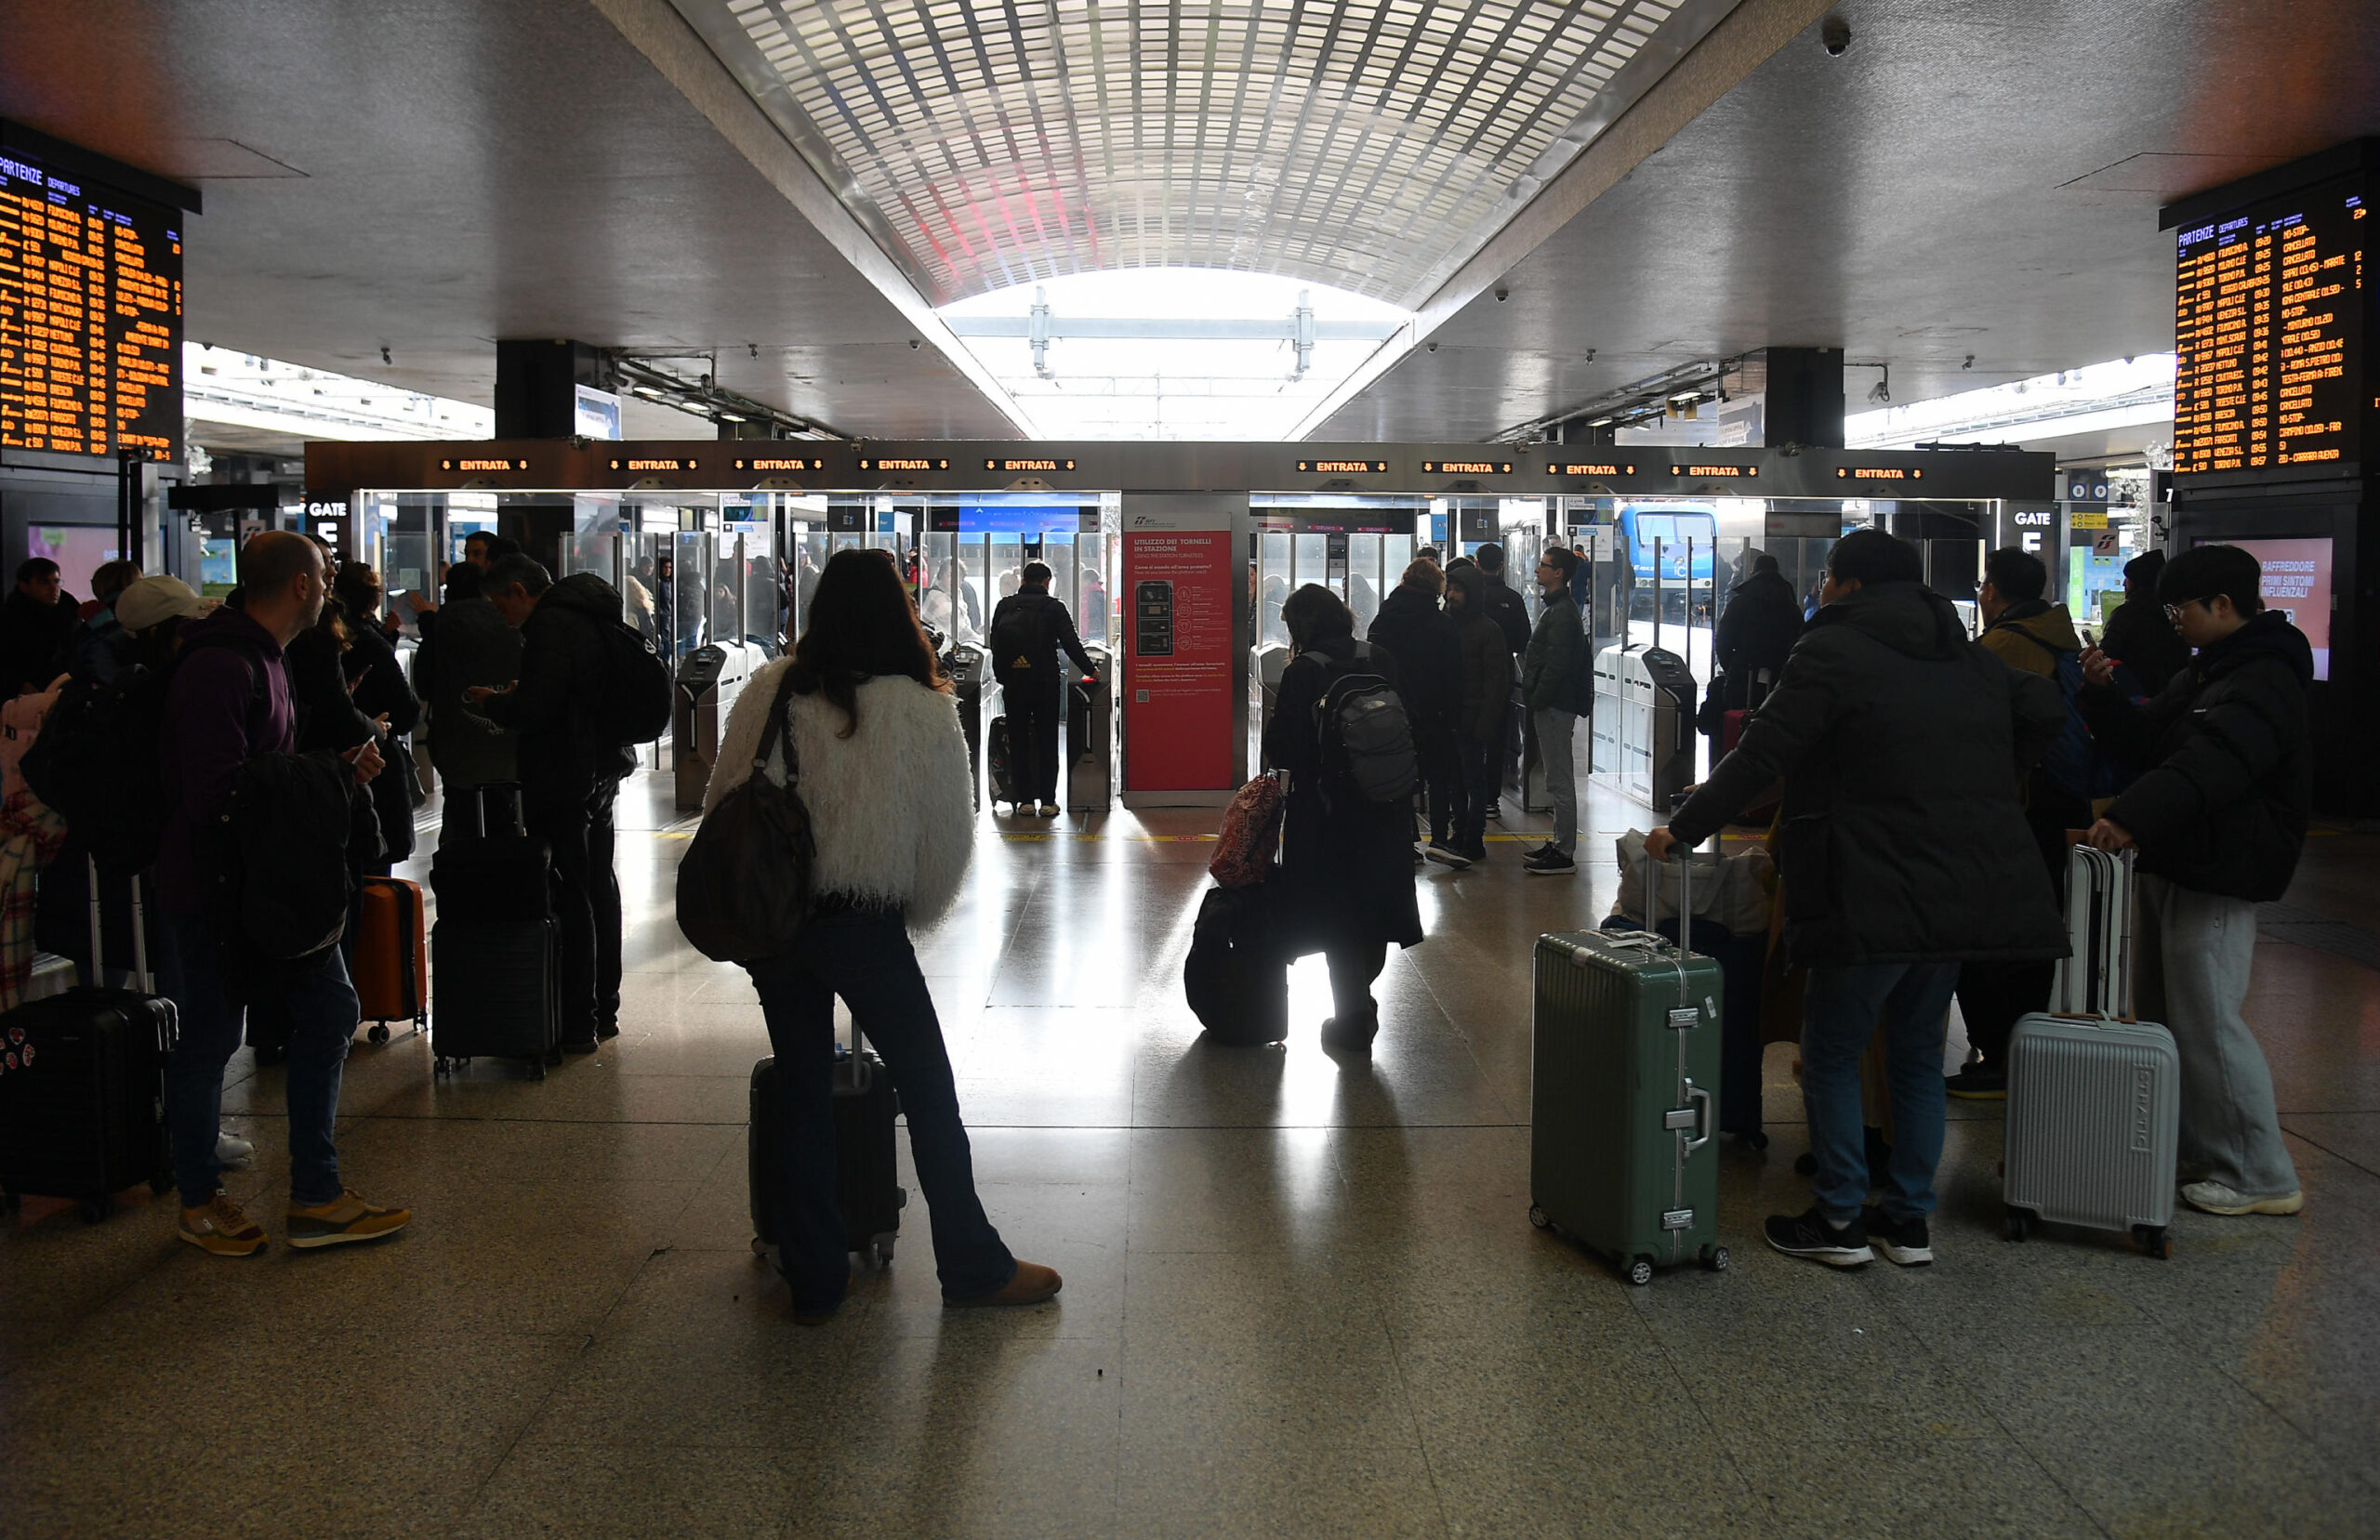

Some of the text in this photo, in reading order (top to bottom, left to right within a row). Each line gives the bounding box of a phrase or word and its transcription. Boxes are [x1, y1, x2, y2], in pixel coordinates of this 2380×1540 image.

[0, 156, 43, 186] PARTENZE
[2178, 224, 2215, 247] PARTENZE
[2218, 217, 2248, 233] DEPARTURES
[2282, 234, 2315, 253] CANCELLATO
[2282, 248, 2315, 266] CANCELLATO
[2217, 296, 2233, 308] NAPOLI
[2356, 265, 2361, 275] 2
[2216, 308, 2236, 321] VENEZIA
[2356, 279, 2361, 289] 5
[2215, 347, 2232, 358] NAPOLI
[2215, 358, 2237, 370] NETTUNO
[2280, 384, 2312, 398] CANCELLATO
[2280, 398, 2311, 411] CANCELLATO
[2214, 447, 2233, 457] VENEZIA
[460, 460, 510, 470] ENTRATA
[628, 460, 679, 470] ENTRATA
[753, 460, 804, 470] ENTRATA
[879, 460, 930, 469] ENTRATA
[1005, 461, 1056, 470] ENTRATA
[1316, 463, 1368, 472] ENTRATA
[1442, 463, 1493, 473] ENTRATA
[1567, 465, 1617, 475] ENTRATA
[1689, 467, 1739, 476] ENTRATA
[1855, 468, 1904, 479] ENTRATA
[309, 502, 347, 517] GATE
[2015, 511, 2051, 526] GATE
[2262, 560, 2315, 572] RAFFREDDORE
[2262, 575, 2315, 586] PRIMI SINTOMI
[2261, 586, 2308, 598] INFLUENZALI
[2134, 1070, 2150, 1149] STRATIC
